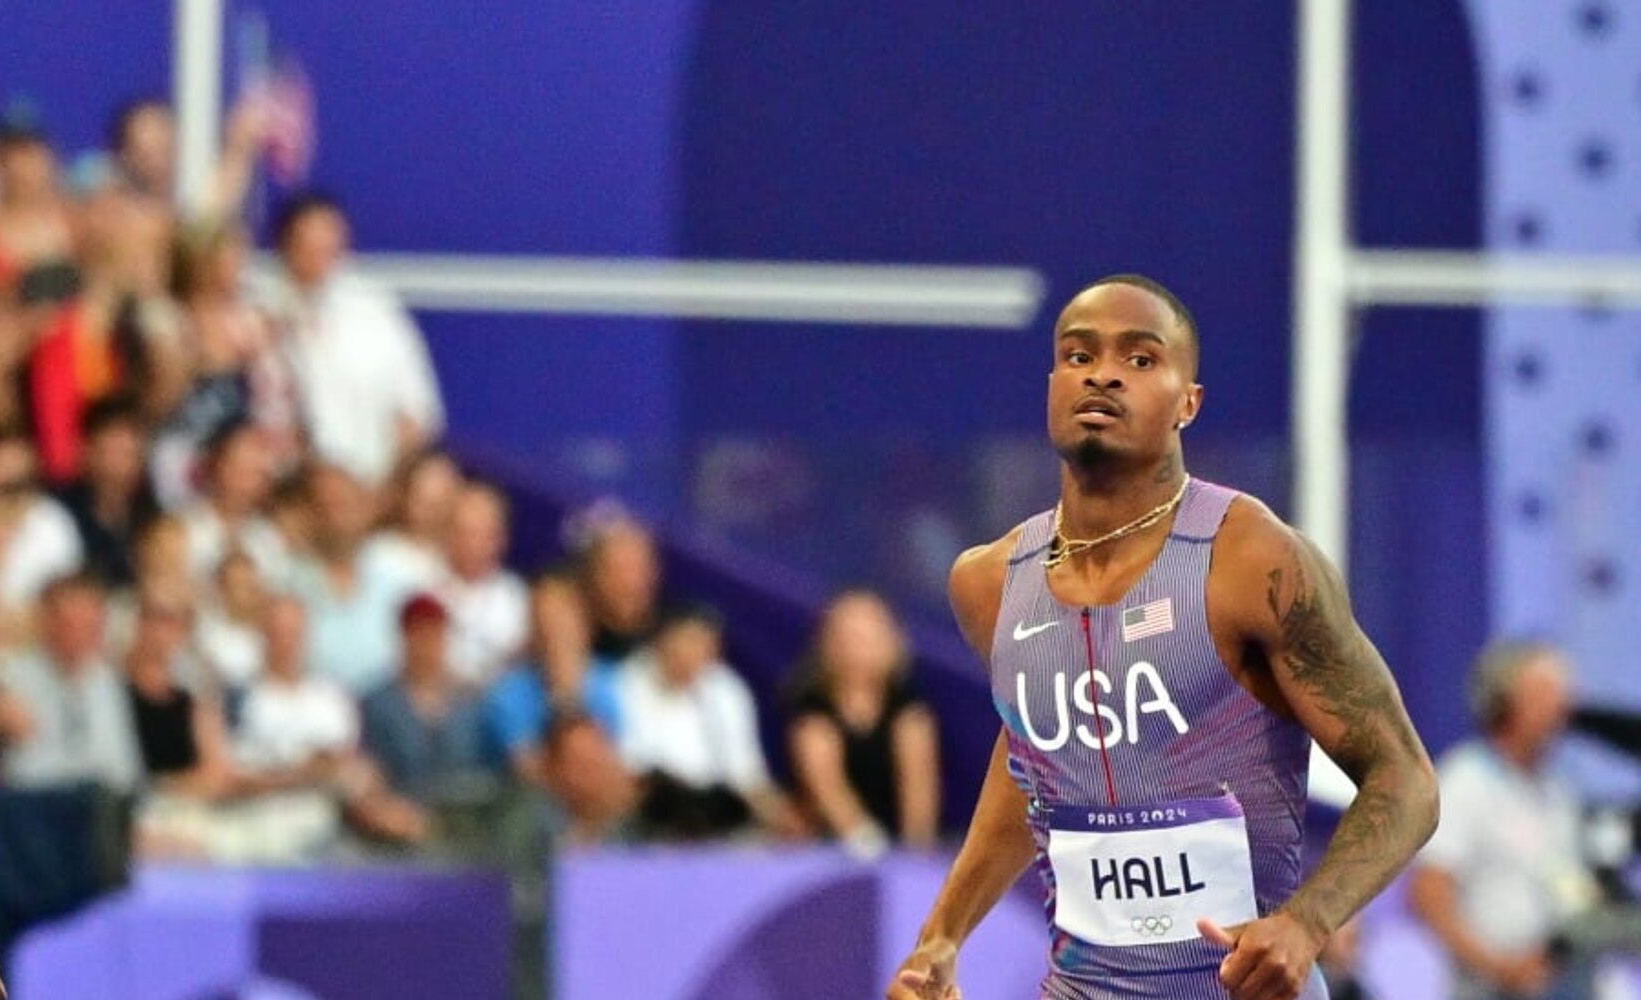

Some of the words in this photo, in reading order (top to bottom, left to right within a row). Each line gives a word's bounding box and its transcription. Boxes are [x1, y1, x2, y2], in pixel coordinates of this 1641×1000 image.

[1016, 660, 1189, 751] USA
[1087, 812, 1135, 827] PARIS
[1140, 802, 1188, 824] 2024
[1090, 851, 1206, 901] HALL
